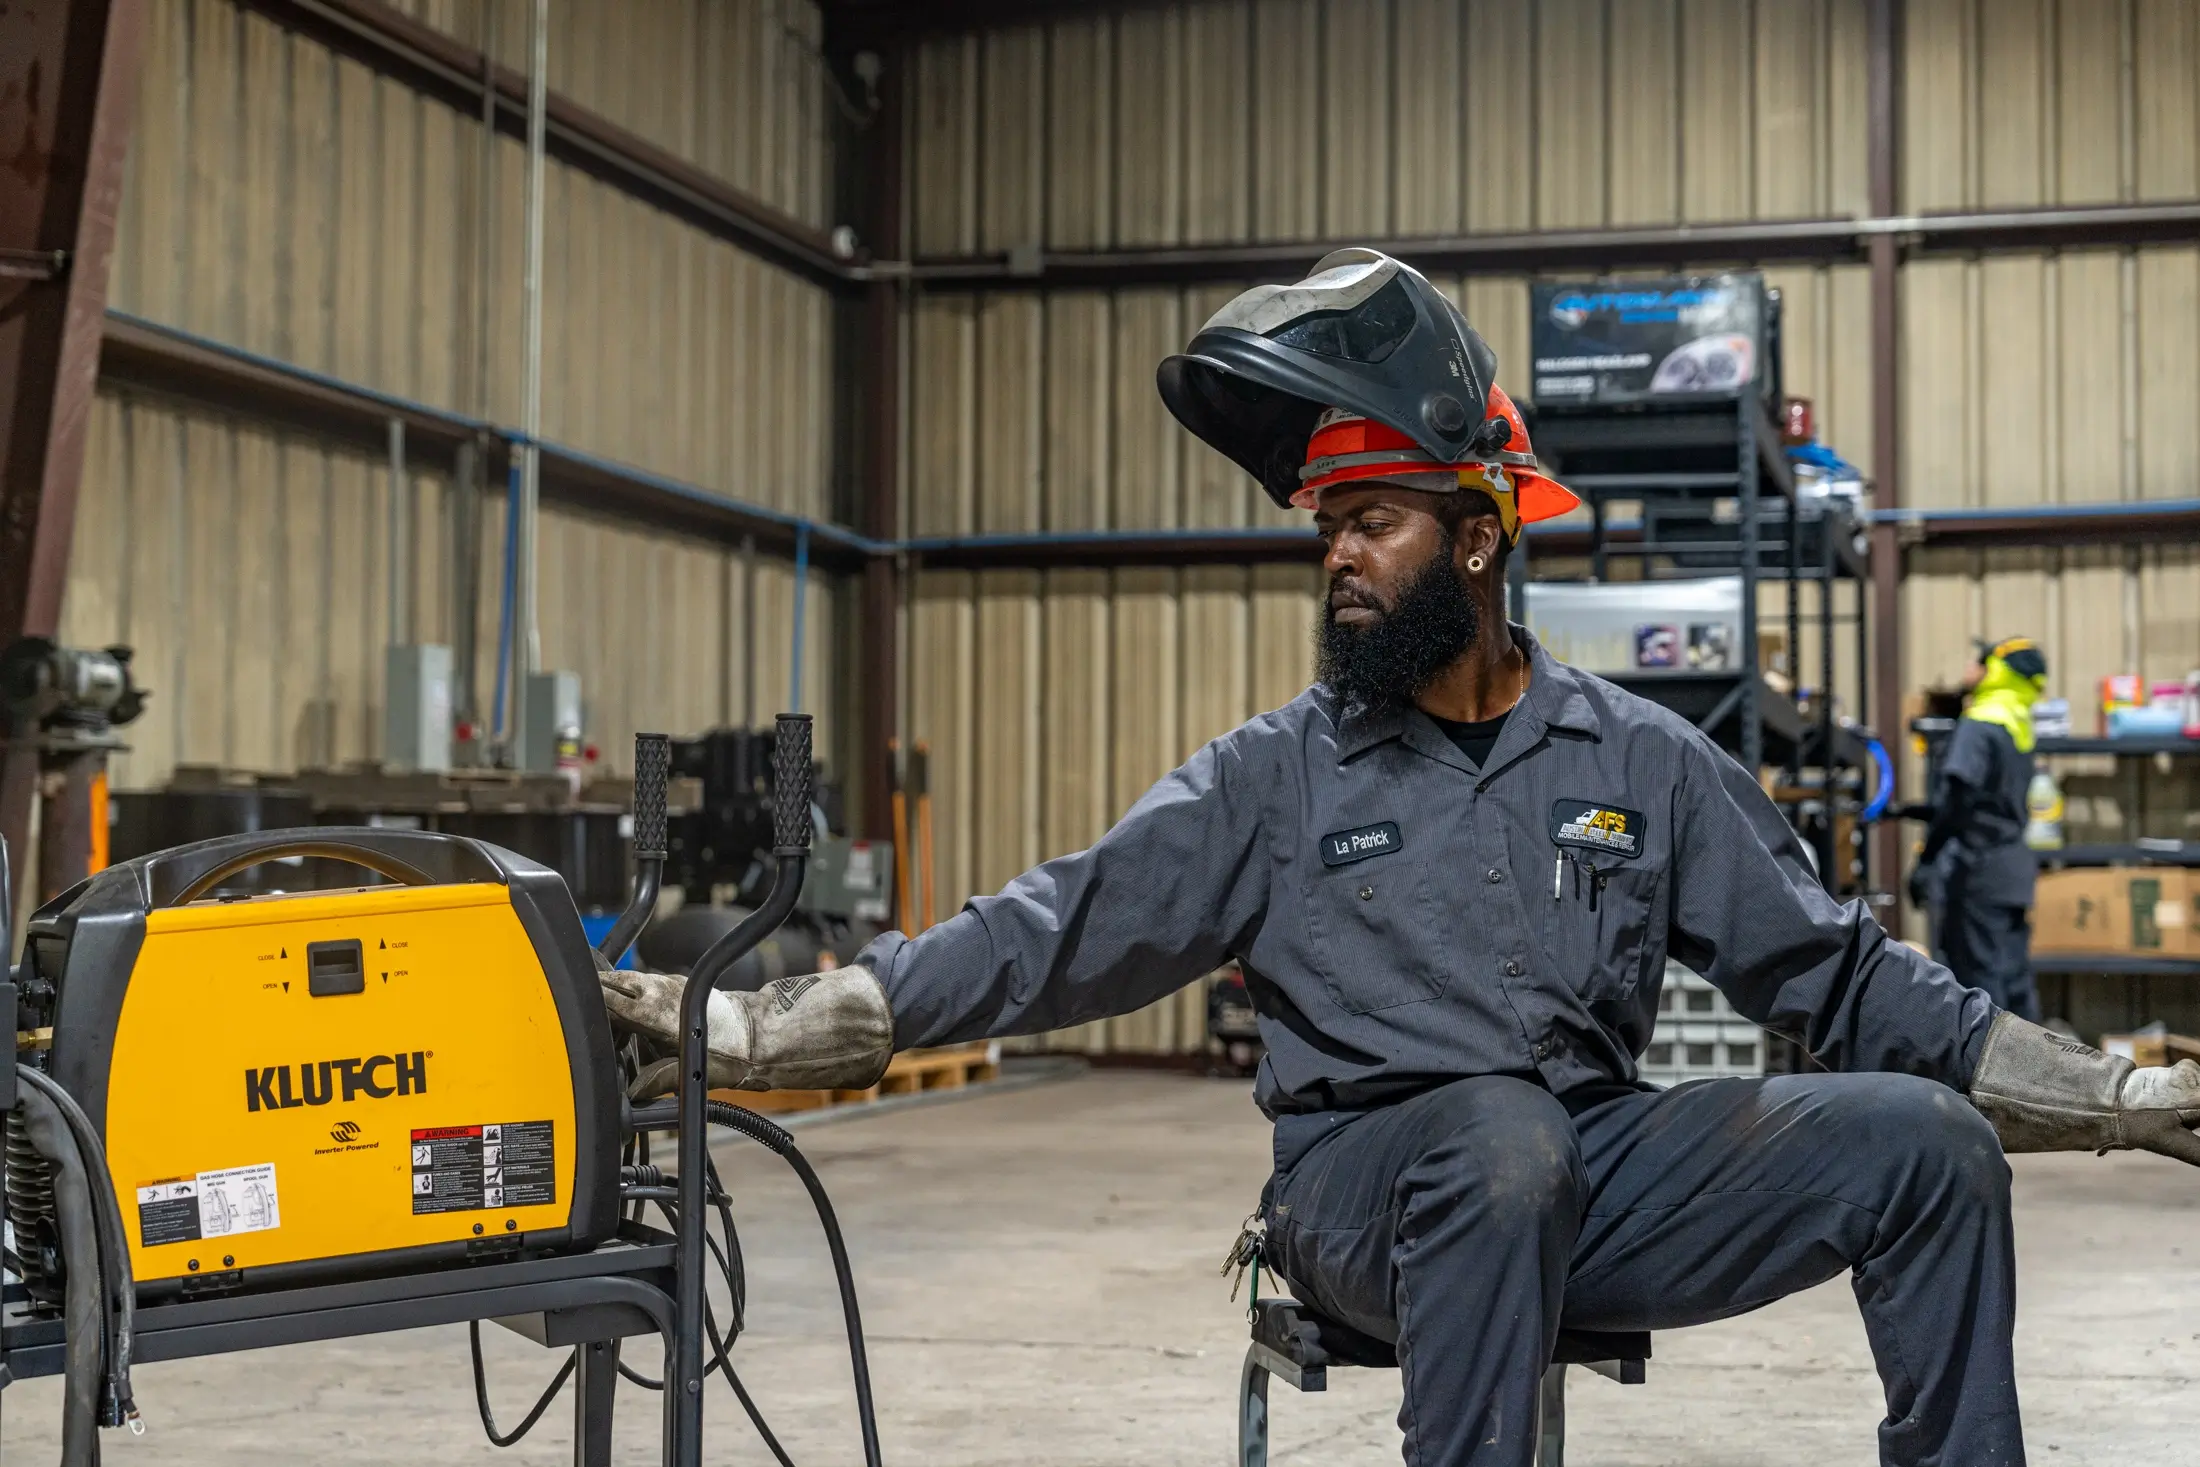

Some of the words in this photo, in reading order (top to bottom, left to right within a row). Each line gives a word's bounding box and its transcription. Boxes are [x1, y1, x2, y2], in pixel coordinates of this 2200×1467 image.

[1449, 360, 1460, 377] 3M
[1455, 350, 1475, 399] Speedglas
[1589, 810, 1627, 833] AFS
[1334, 840, 1350, 855] La
[1351, 830, 1389, 852] Patrick
[1558, 832, 1580, 840] MOBILE
[391, 941, 408, 949] CLOSE
[245, 1051, 427, 1112] KLUTCH
[431, 1127, 469, 1137] WARNING
[314, 1145, 344, 1155] Inverter
[346, 1141, 379, 1152] Powered
[225, 1168, 256, 1178] CONNECTION
[256, 1166, 272, 1174] GUIDE
